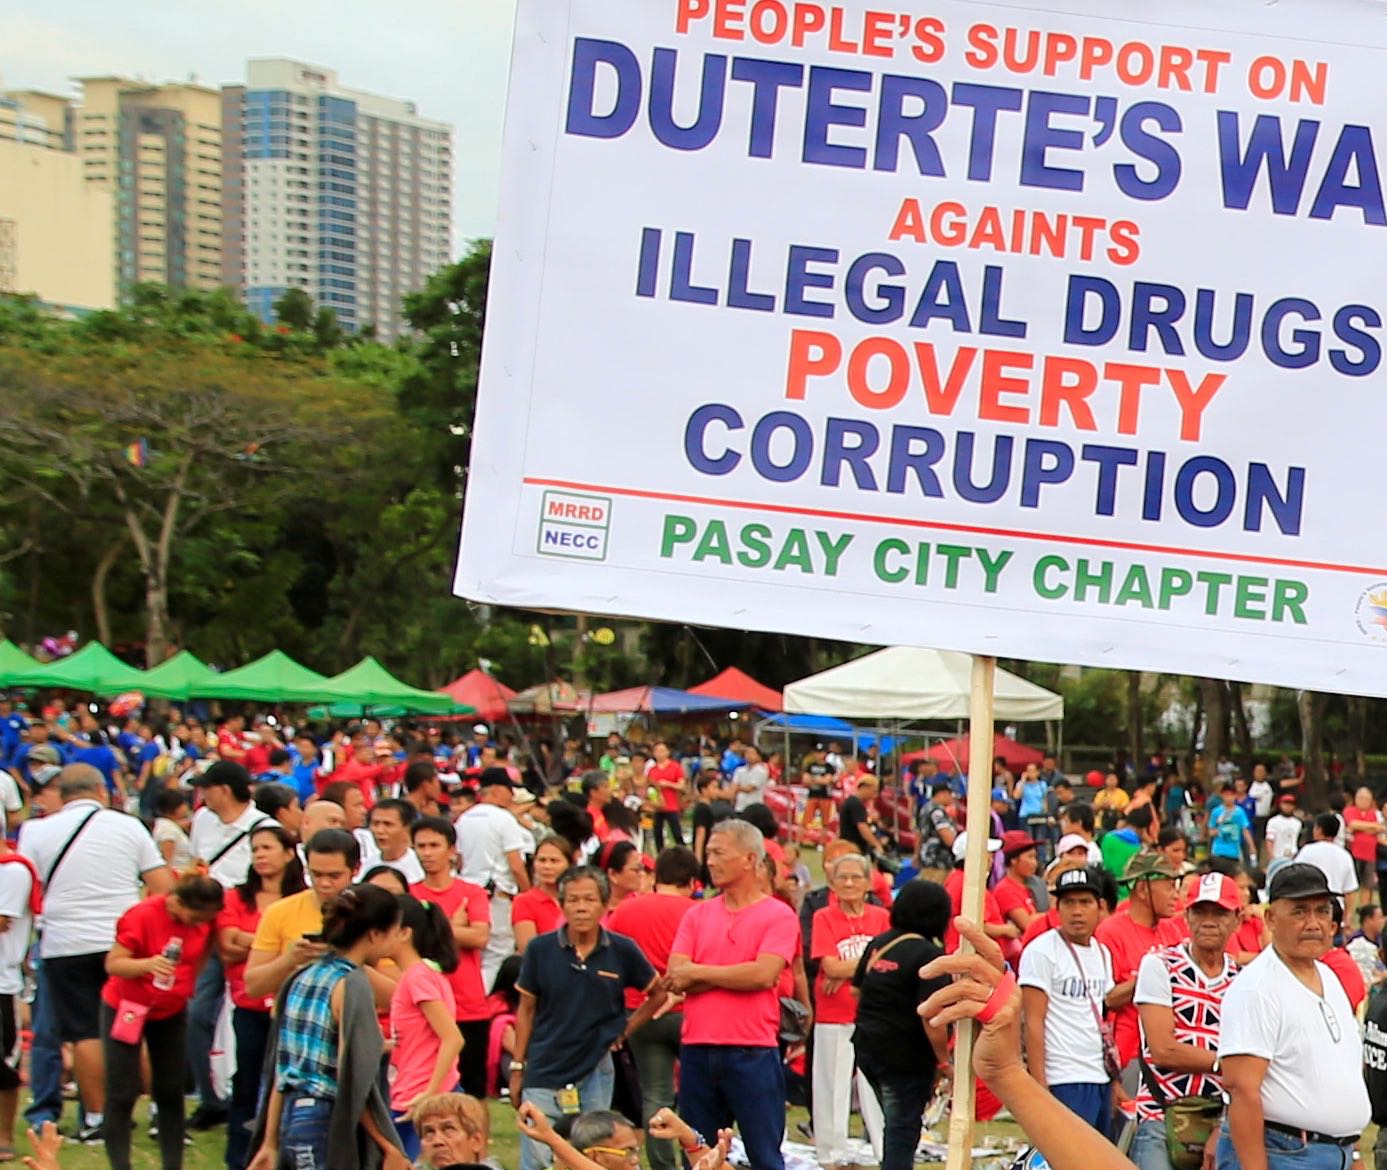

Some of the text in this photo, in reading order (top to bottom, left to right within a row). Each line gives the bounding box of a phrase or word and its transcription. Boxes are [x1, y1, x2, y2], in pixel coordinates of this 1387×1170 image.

[676, 0, 1328, 105] PEOPLE'S SUPPORT ON
[565, 36, 1183, 201] DUTERTE'S
[888, 198, 1141, 265] AGAINTS
[635, 227, 1383, 377] ILLEGAL DRUGS
[785, 329, 1227, 442] POVERTY
[547, 501, 604, 523] MRRD
[683, 403, 1306, 536] CORRUPTION
[544, 529, 599, 551] NECC
[660, 513, 855, 577] PASAY
[873, 537, 1014, 594] CITY
[1032, 554, 1309, 625] CHAPTER
